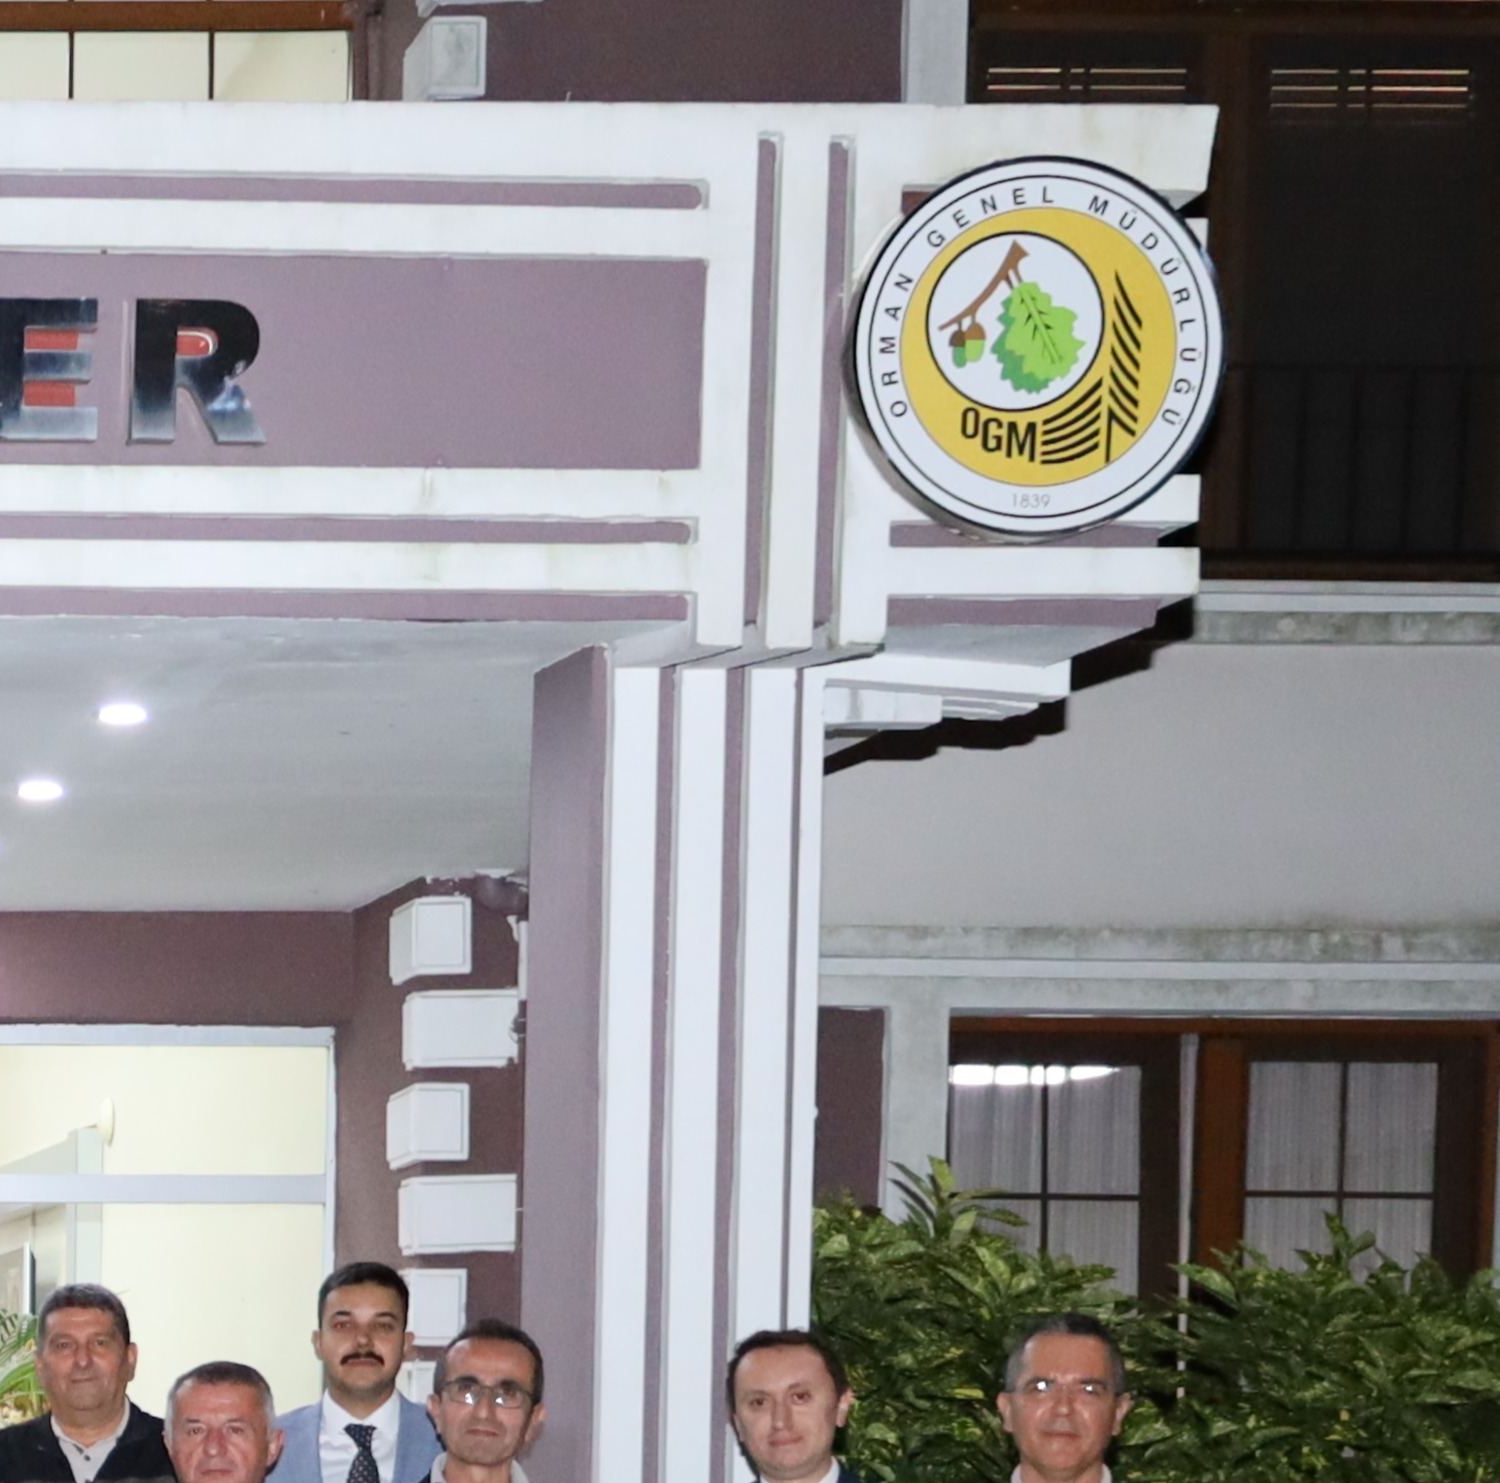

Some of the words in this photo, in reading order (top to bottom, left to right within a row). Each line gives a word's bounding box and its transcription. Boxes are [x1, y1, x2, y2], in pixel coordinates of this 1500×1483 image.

[880, 273, 914, 418] ORMAN
[926, 185, 1055, 249] GENEL
[1087, 194, 1202, 427] MÜDÜRLÜĞÜ
[961, 407, 1038, 463] OGM
[1010, 492, 1051, 509] 1839
